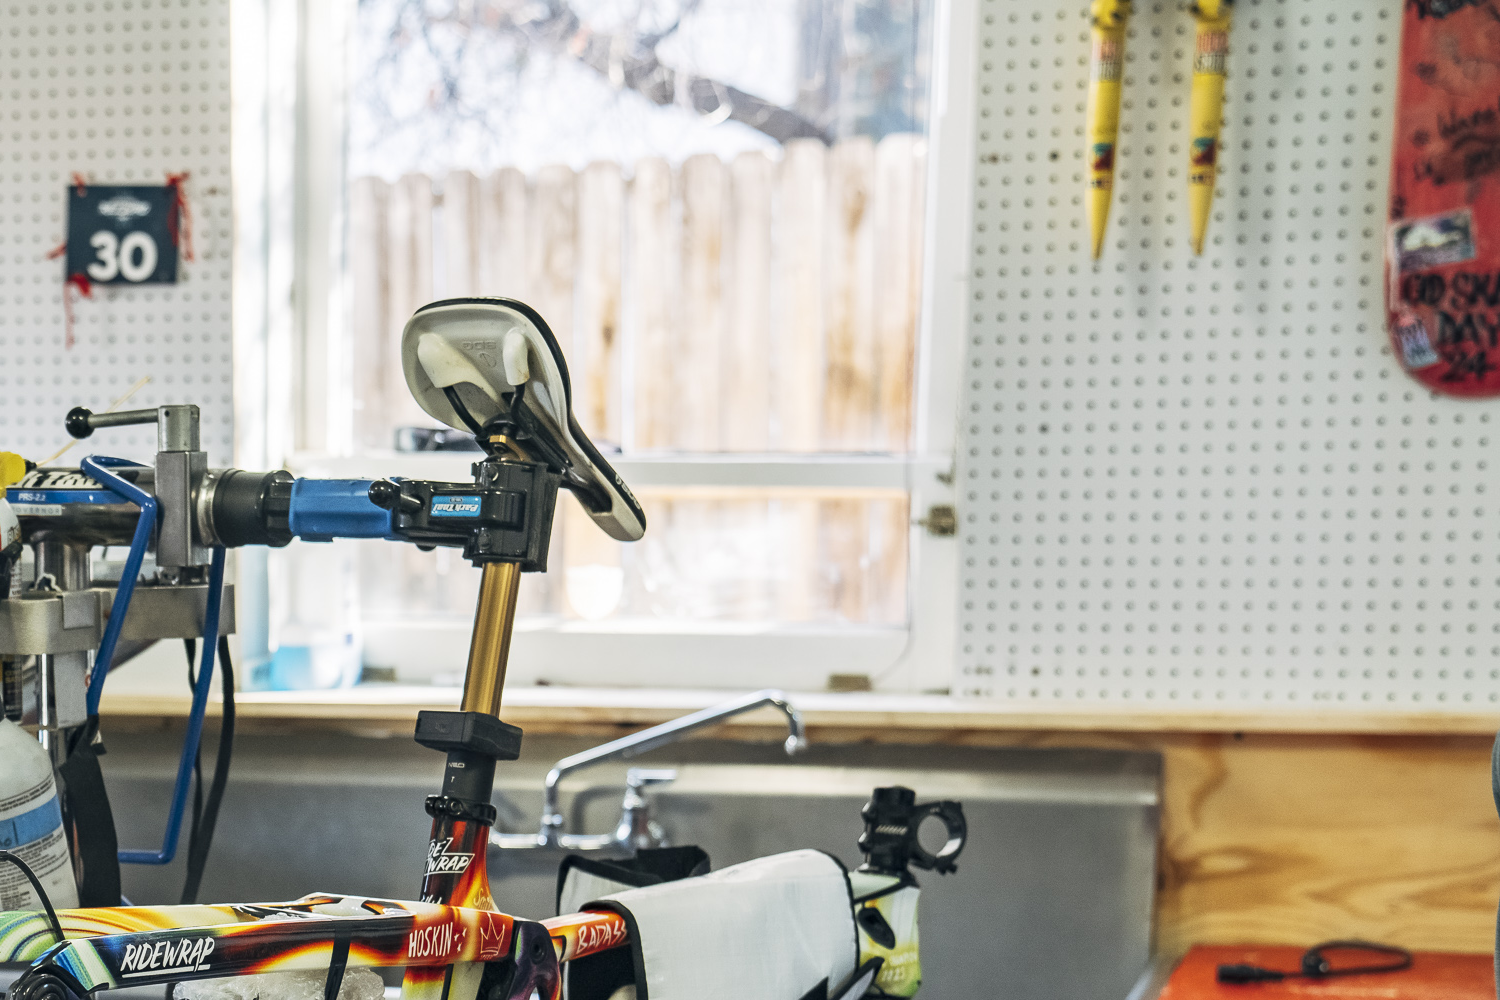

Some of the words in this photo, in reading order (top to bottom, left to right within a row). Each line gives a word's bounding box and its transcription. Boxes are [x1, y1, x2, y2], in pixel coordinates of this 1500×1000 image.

[87, 230, 158, 282] 30
[120, 936, 216, 973] RIDEWRAP
[408, 921, 454, 958] HOSKIN
[575, 920, 629, 955] BADASS
